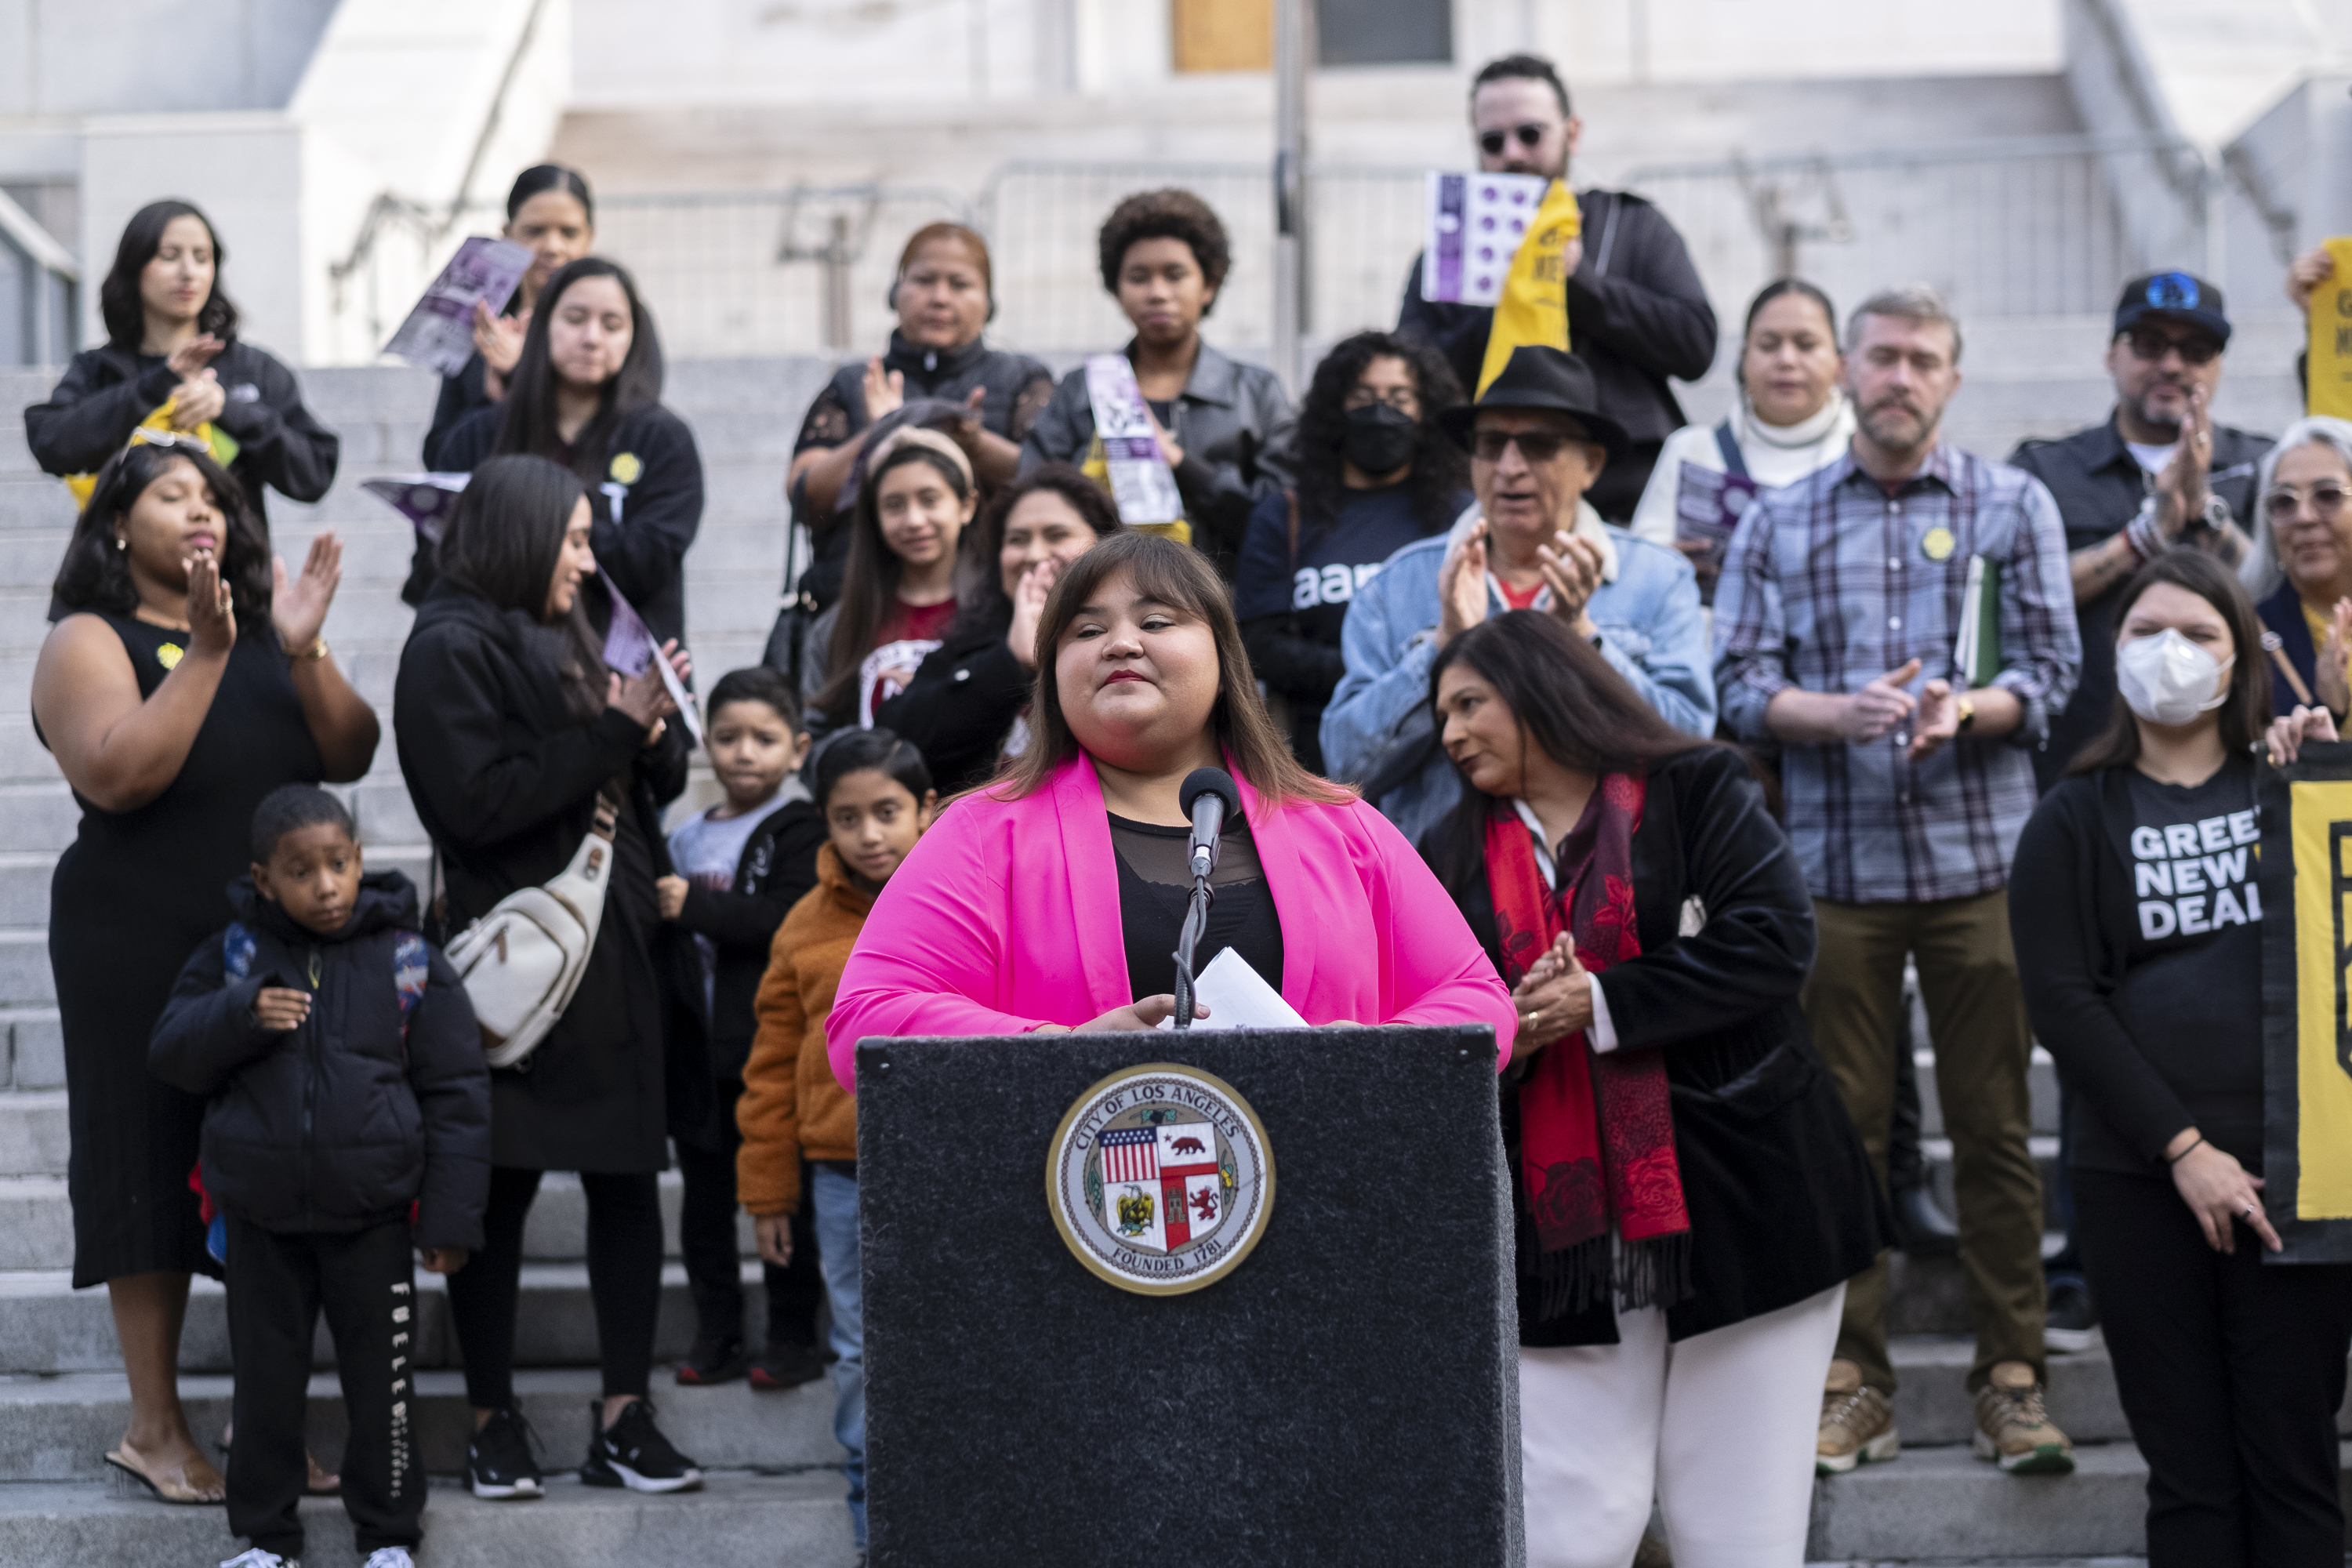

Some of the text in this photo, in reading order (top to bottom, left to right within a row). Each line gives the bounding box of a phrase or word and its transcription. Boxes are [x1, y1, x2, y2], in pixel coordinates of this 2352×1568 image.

[1293, 563, 1385, 610] aar
[2131, 804, 2261, 860] GREE
[2134, 847, 2248, 898] NEW
[1076, 1085, 1240, 1150] CITY OF LOS ANGELES
[1112, 1240, 1221, 1272] FOUNDED 1781
